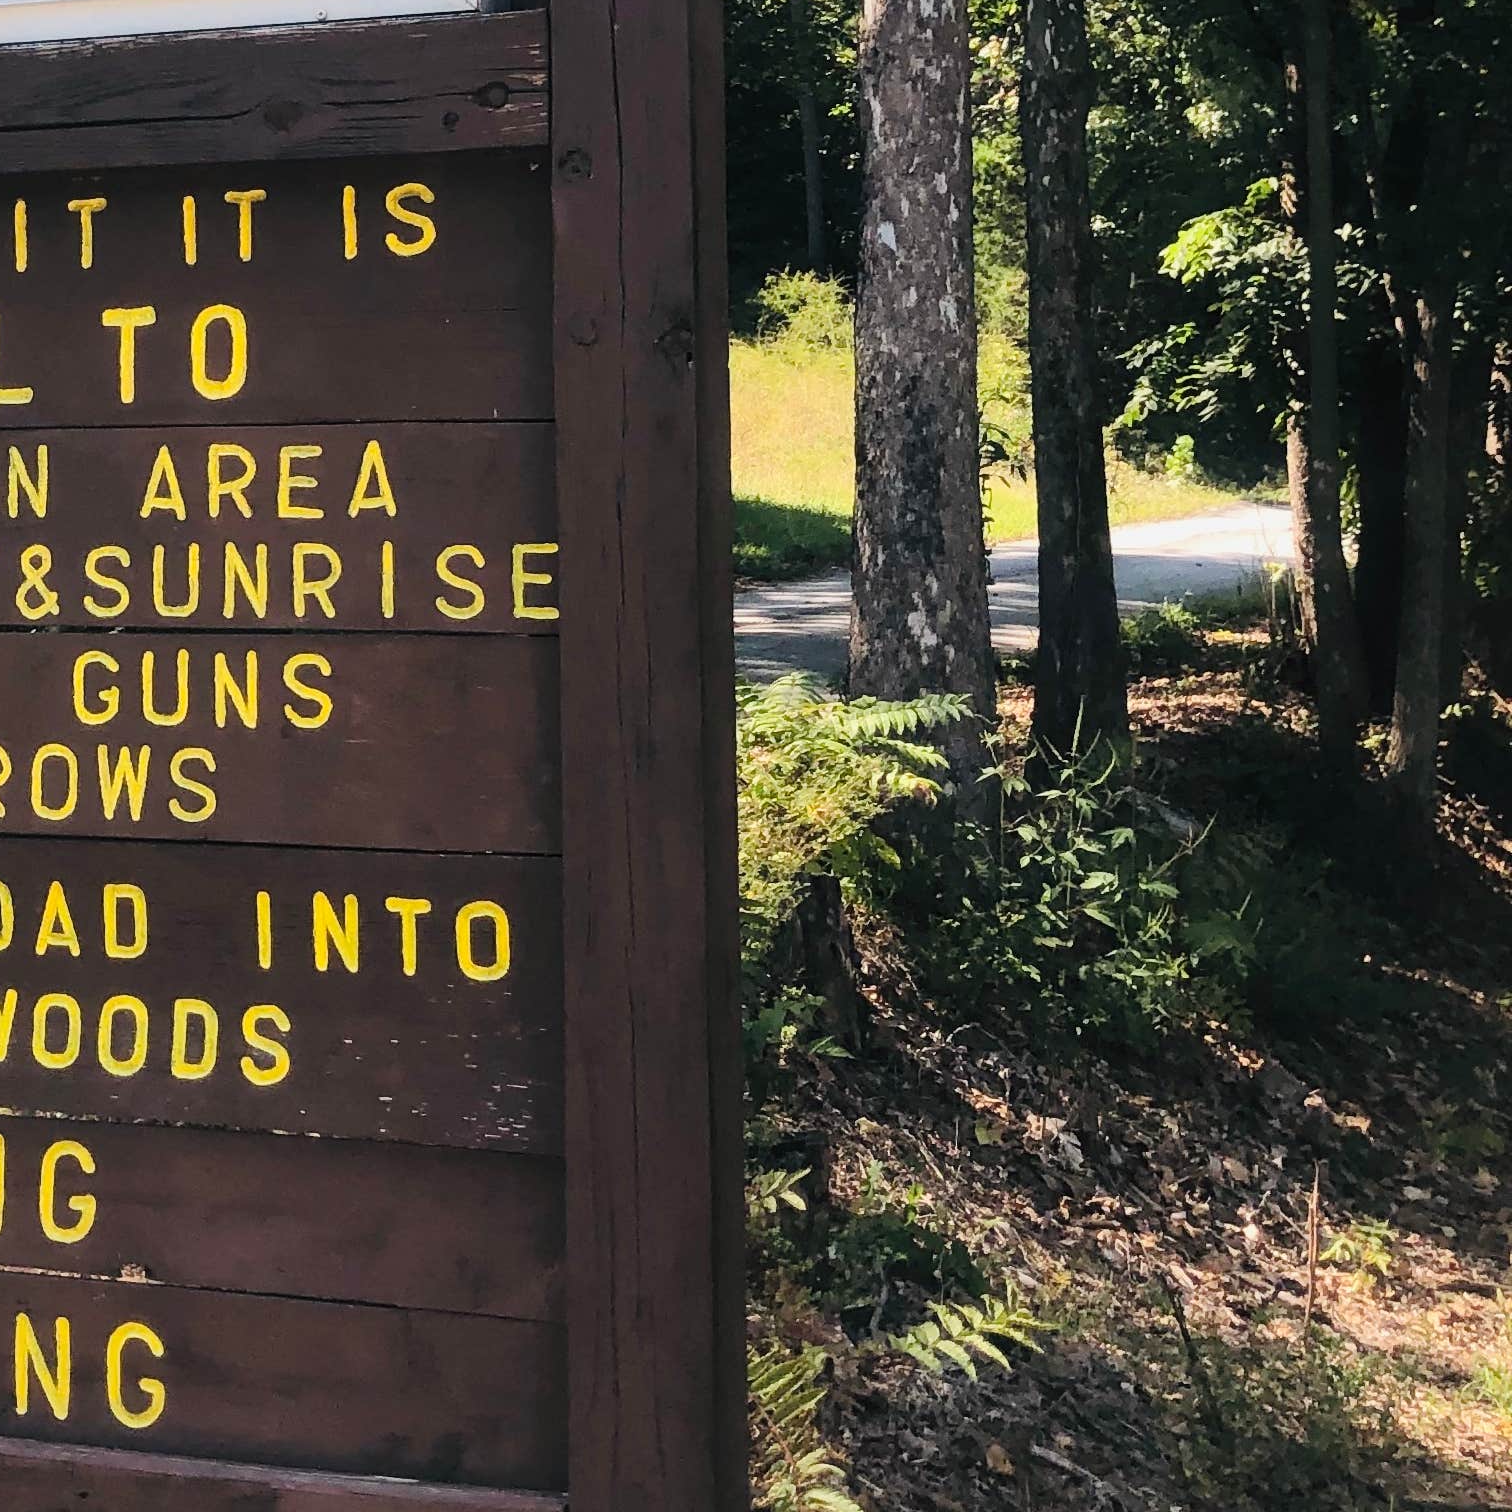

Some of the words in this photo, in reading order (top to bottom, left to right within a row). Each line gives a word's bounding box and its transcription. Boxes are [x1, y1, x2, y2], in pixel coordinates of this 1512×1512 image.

[181, 188, 268, 267] IT
[341, 181, 438, 261] IS
[100, 302, 249, 405] TO
[138, 438, 398, 522] AREA
[71, 647, 335, 731] GUNS
[255, 889, 512, 983] INTO
